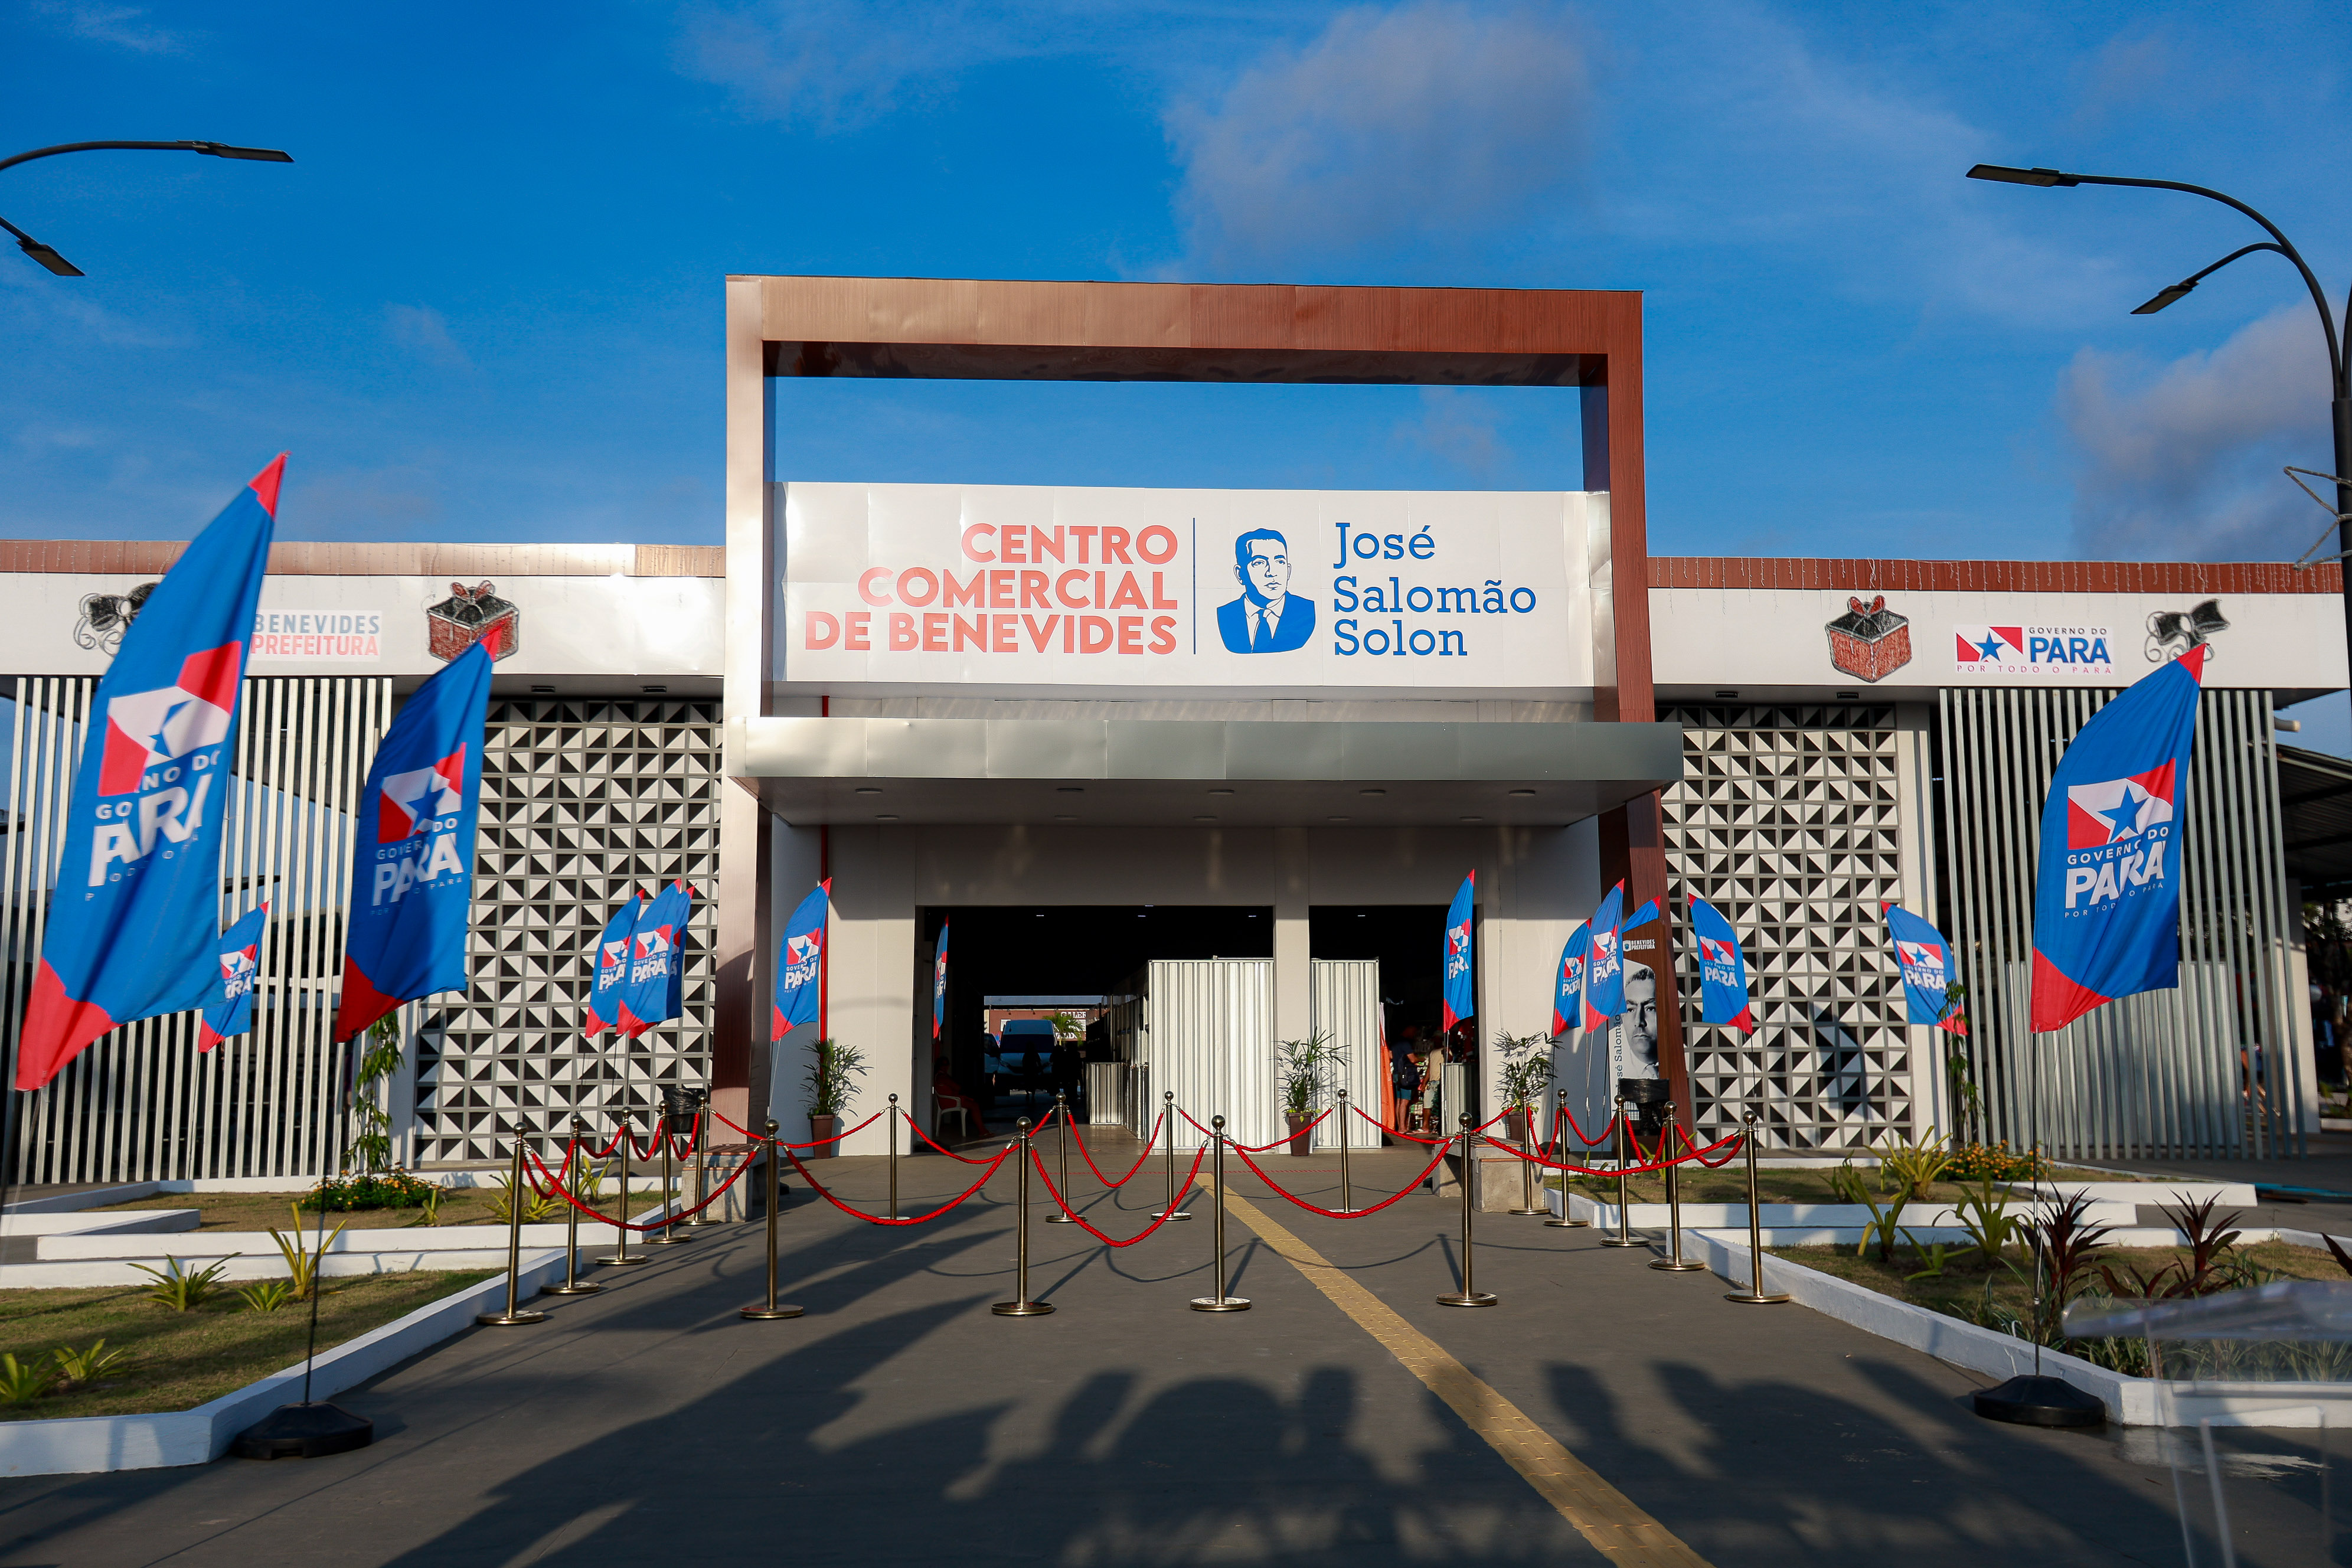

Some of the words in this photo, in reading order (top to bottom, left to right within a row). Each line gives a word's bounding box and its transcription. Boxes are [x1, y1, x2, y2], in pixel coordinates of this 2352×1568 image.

[961, 523, 1178, 564] CENTRO
[1333, 522, 1435, 569] José
[858, 567, 1178, 610] COMERCIAL
[1333, 576, 1536, 613] Salomão
[254, 613, 380, 633] BENEVIDES
[805, 612, 871, 651] DE
[889, 612, 1177, 655] BENEVIDES
[1334, 619, 1468, 656] Solon
[250, 634, 378, 655] PREFEITURA
[432, 818, 458, 833] DO
[2067, 839, 2141, 865] GOVERNO
[2147, 827, 2168, 839] DO
[2096, 897, 2121, 913] TOD
[1613, 1014, 1623, 1061] Salomão
